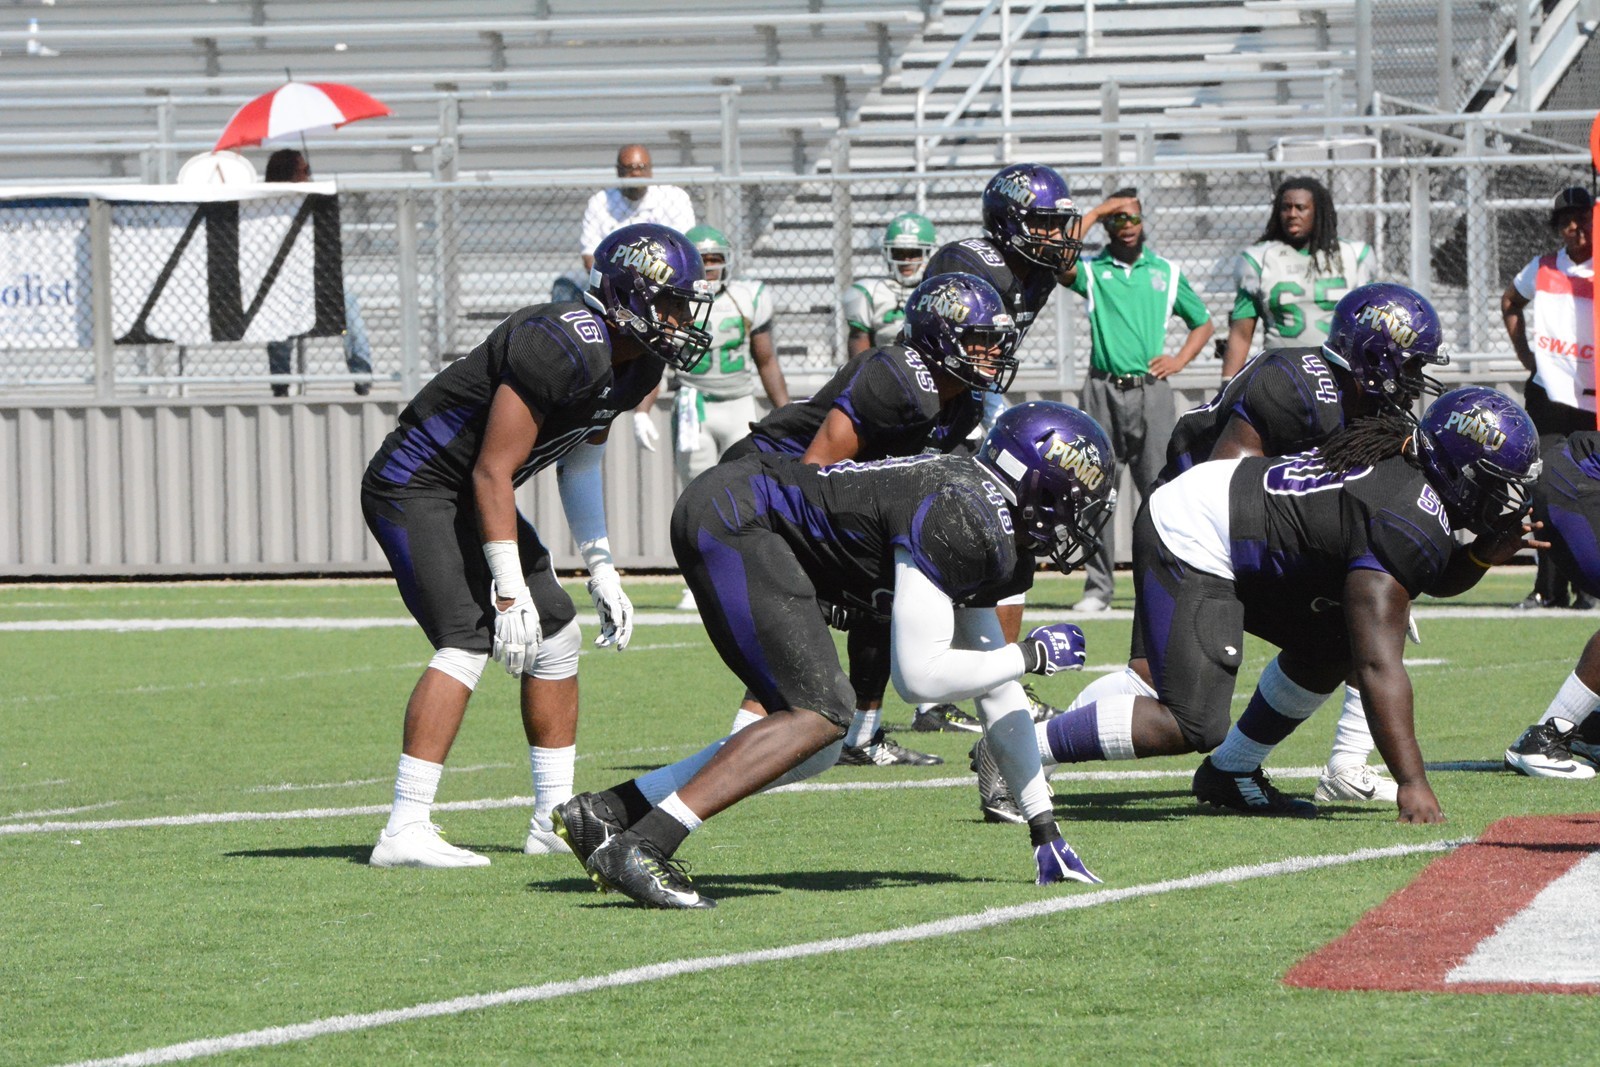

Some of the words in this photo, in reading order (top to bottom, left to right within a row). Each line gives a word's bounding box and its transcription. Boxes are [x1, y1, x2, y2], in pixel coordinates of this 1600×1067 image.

[992, 177, 1037, 208] PVAMU
[610, 244, 674, 285] PVAMU
[560, 309, 604, 343] 16
[917, 294, 971, 323] PVAMU
[1358, 306, 1419, 349] PVAMU
[1537, 336, 1594, 360] SWAC
[1302, 354, 1338, 404] 44
[1443, 410, 1507, 451] PVAMU
[1044, 439, 1104, 491] PVAMU
